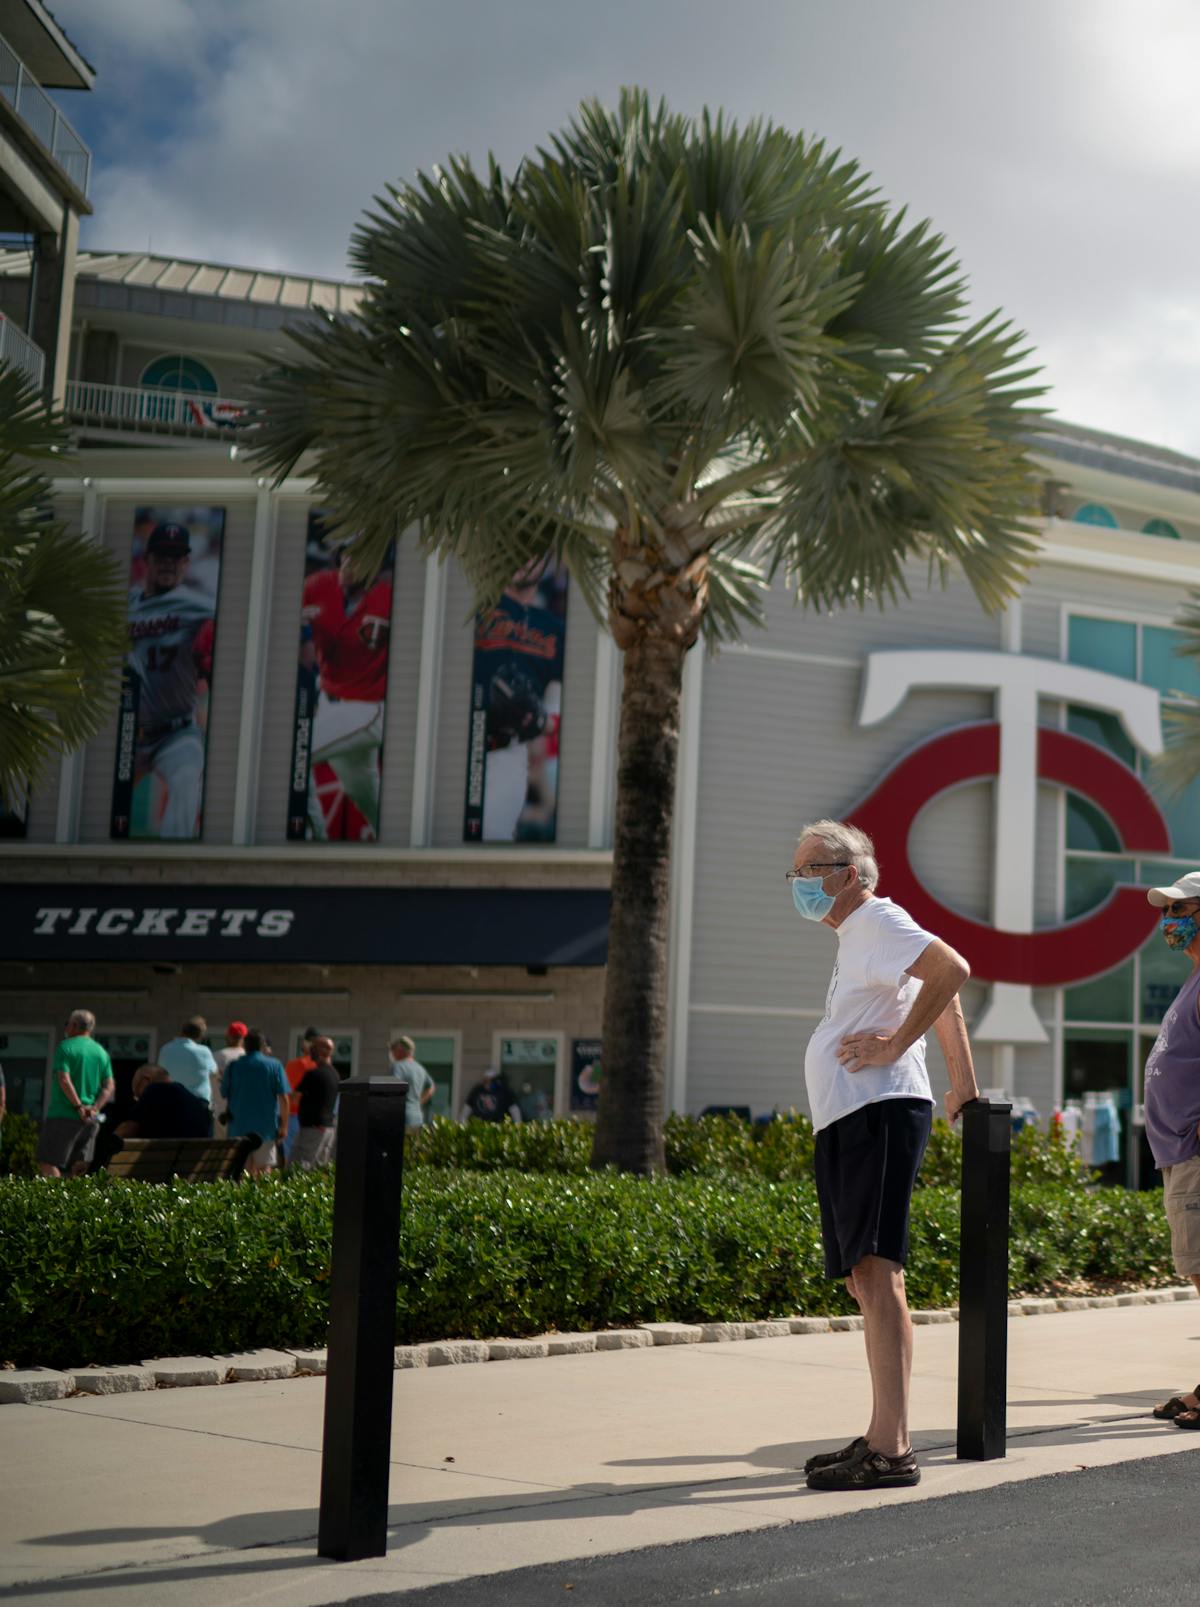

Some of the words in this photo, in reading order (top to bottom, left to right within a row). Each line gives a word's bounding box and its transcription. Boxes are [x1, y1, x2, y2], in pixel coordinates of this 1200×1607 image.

[147, 645, 177, 672] 17
[293, 717, 310, 792] POLANCO
[33, 907, 296, 938] TICKETS
